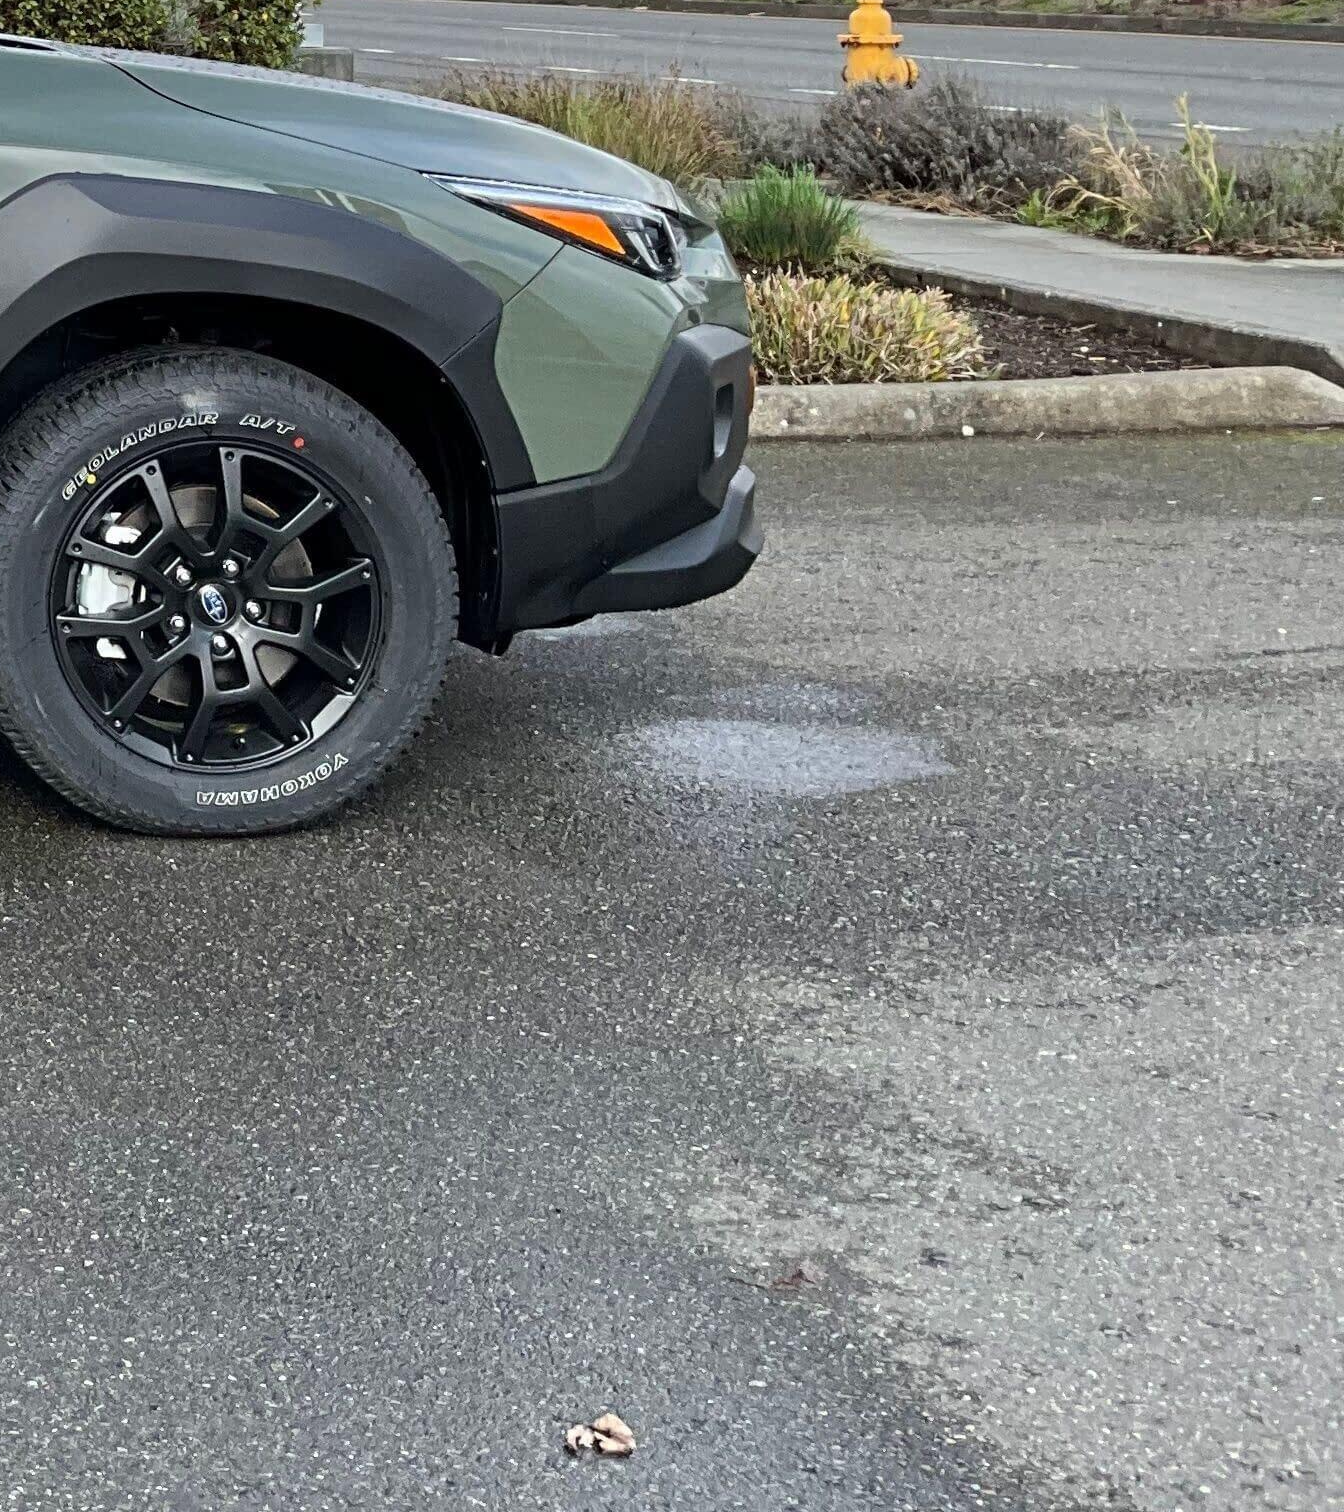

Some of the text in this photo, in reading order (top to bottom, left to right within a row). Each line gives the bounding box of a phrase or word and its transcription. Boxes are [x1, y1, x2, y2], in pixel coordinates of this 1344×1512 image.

[62, 412, 296, 501] GEOLANDAR A/T
[197, 753, 349, 805] YOKOHAMA
